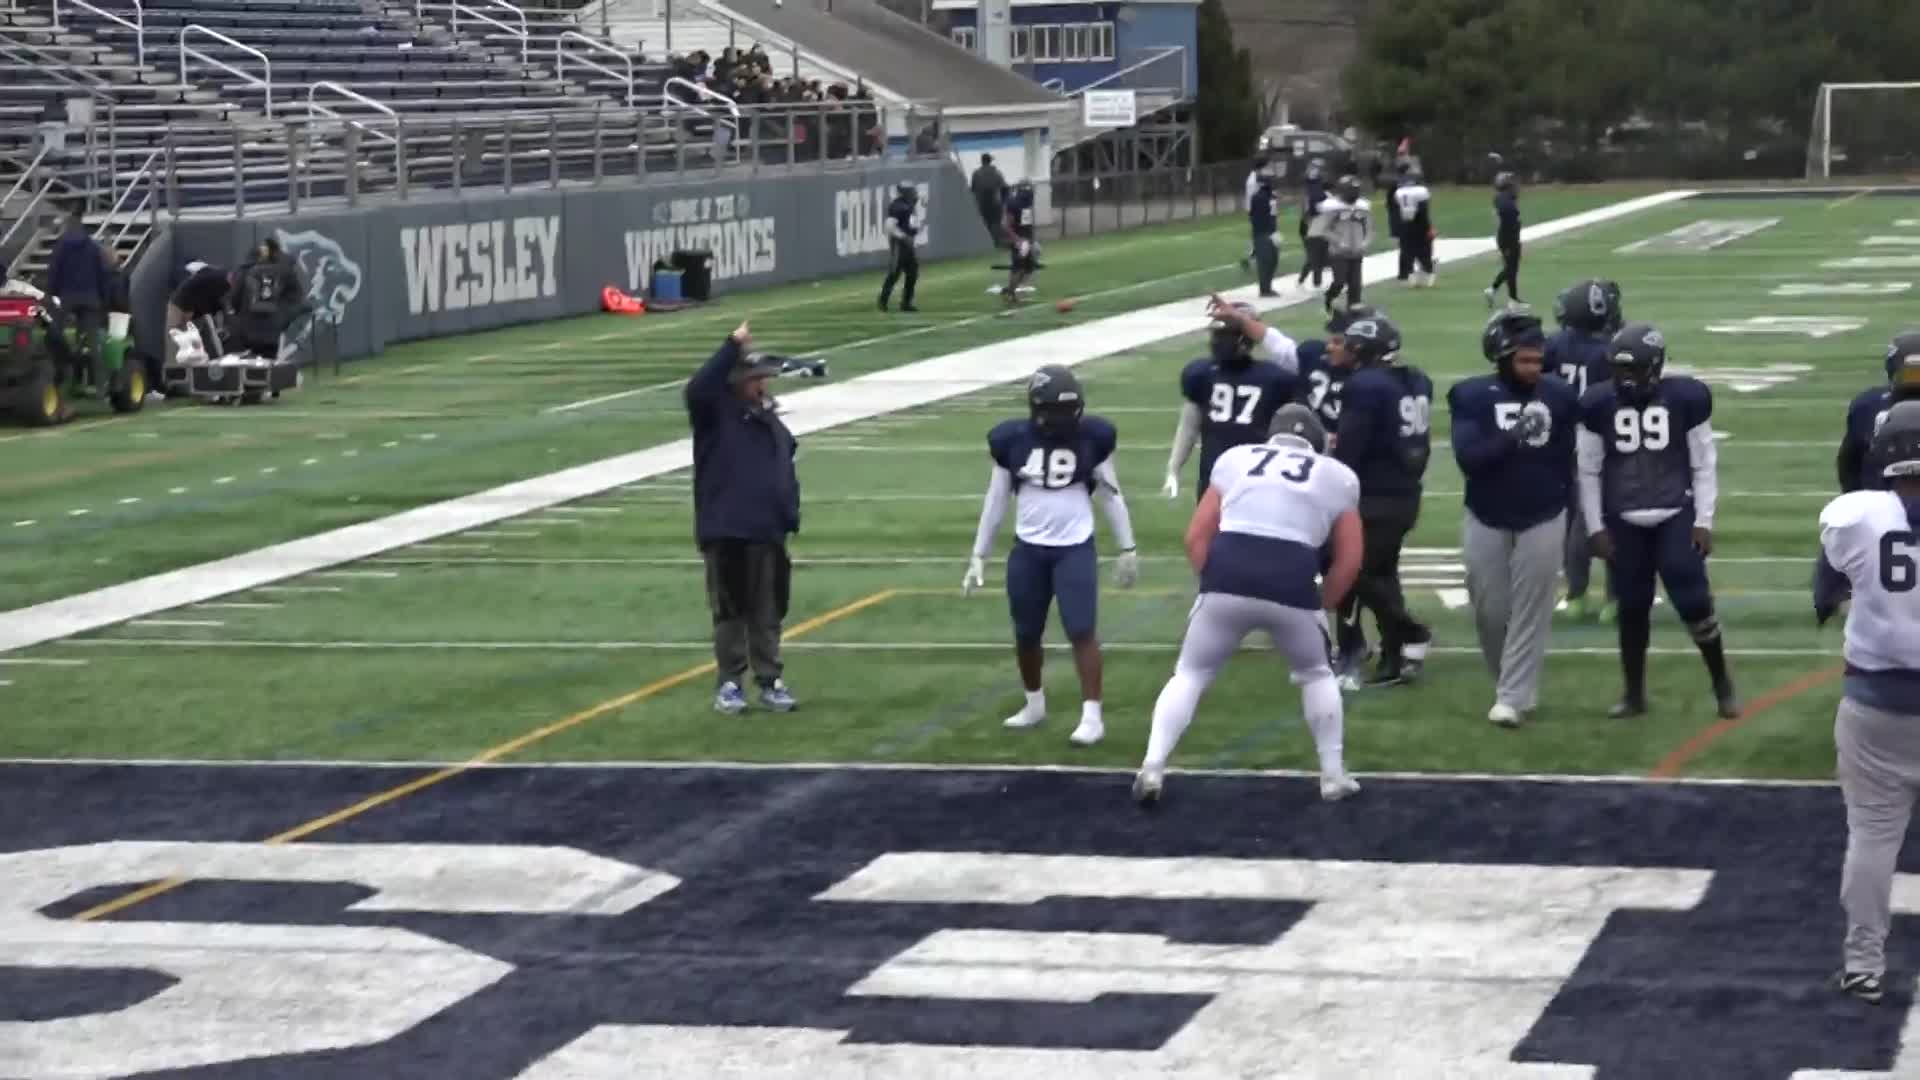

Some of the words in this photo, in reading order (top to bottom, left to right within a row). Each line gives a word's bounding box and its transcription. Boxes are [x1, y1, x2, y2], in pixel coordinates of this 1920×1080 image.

[835, 182, 929, 257] COLLE
[401, 216, 560, 315] WESLEY
[1560, 363, 1588, 400] 71
[1209, 383, 1262, 424] 97
[1400, 395, 1429, 437] 90
[1614, 406, 1670, 453] 99
[1016, 447, 1077, 489] 48
[1247, 447, 1315, 483] 73
